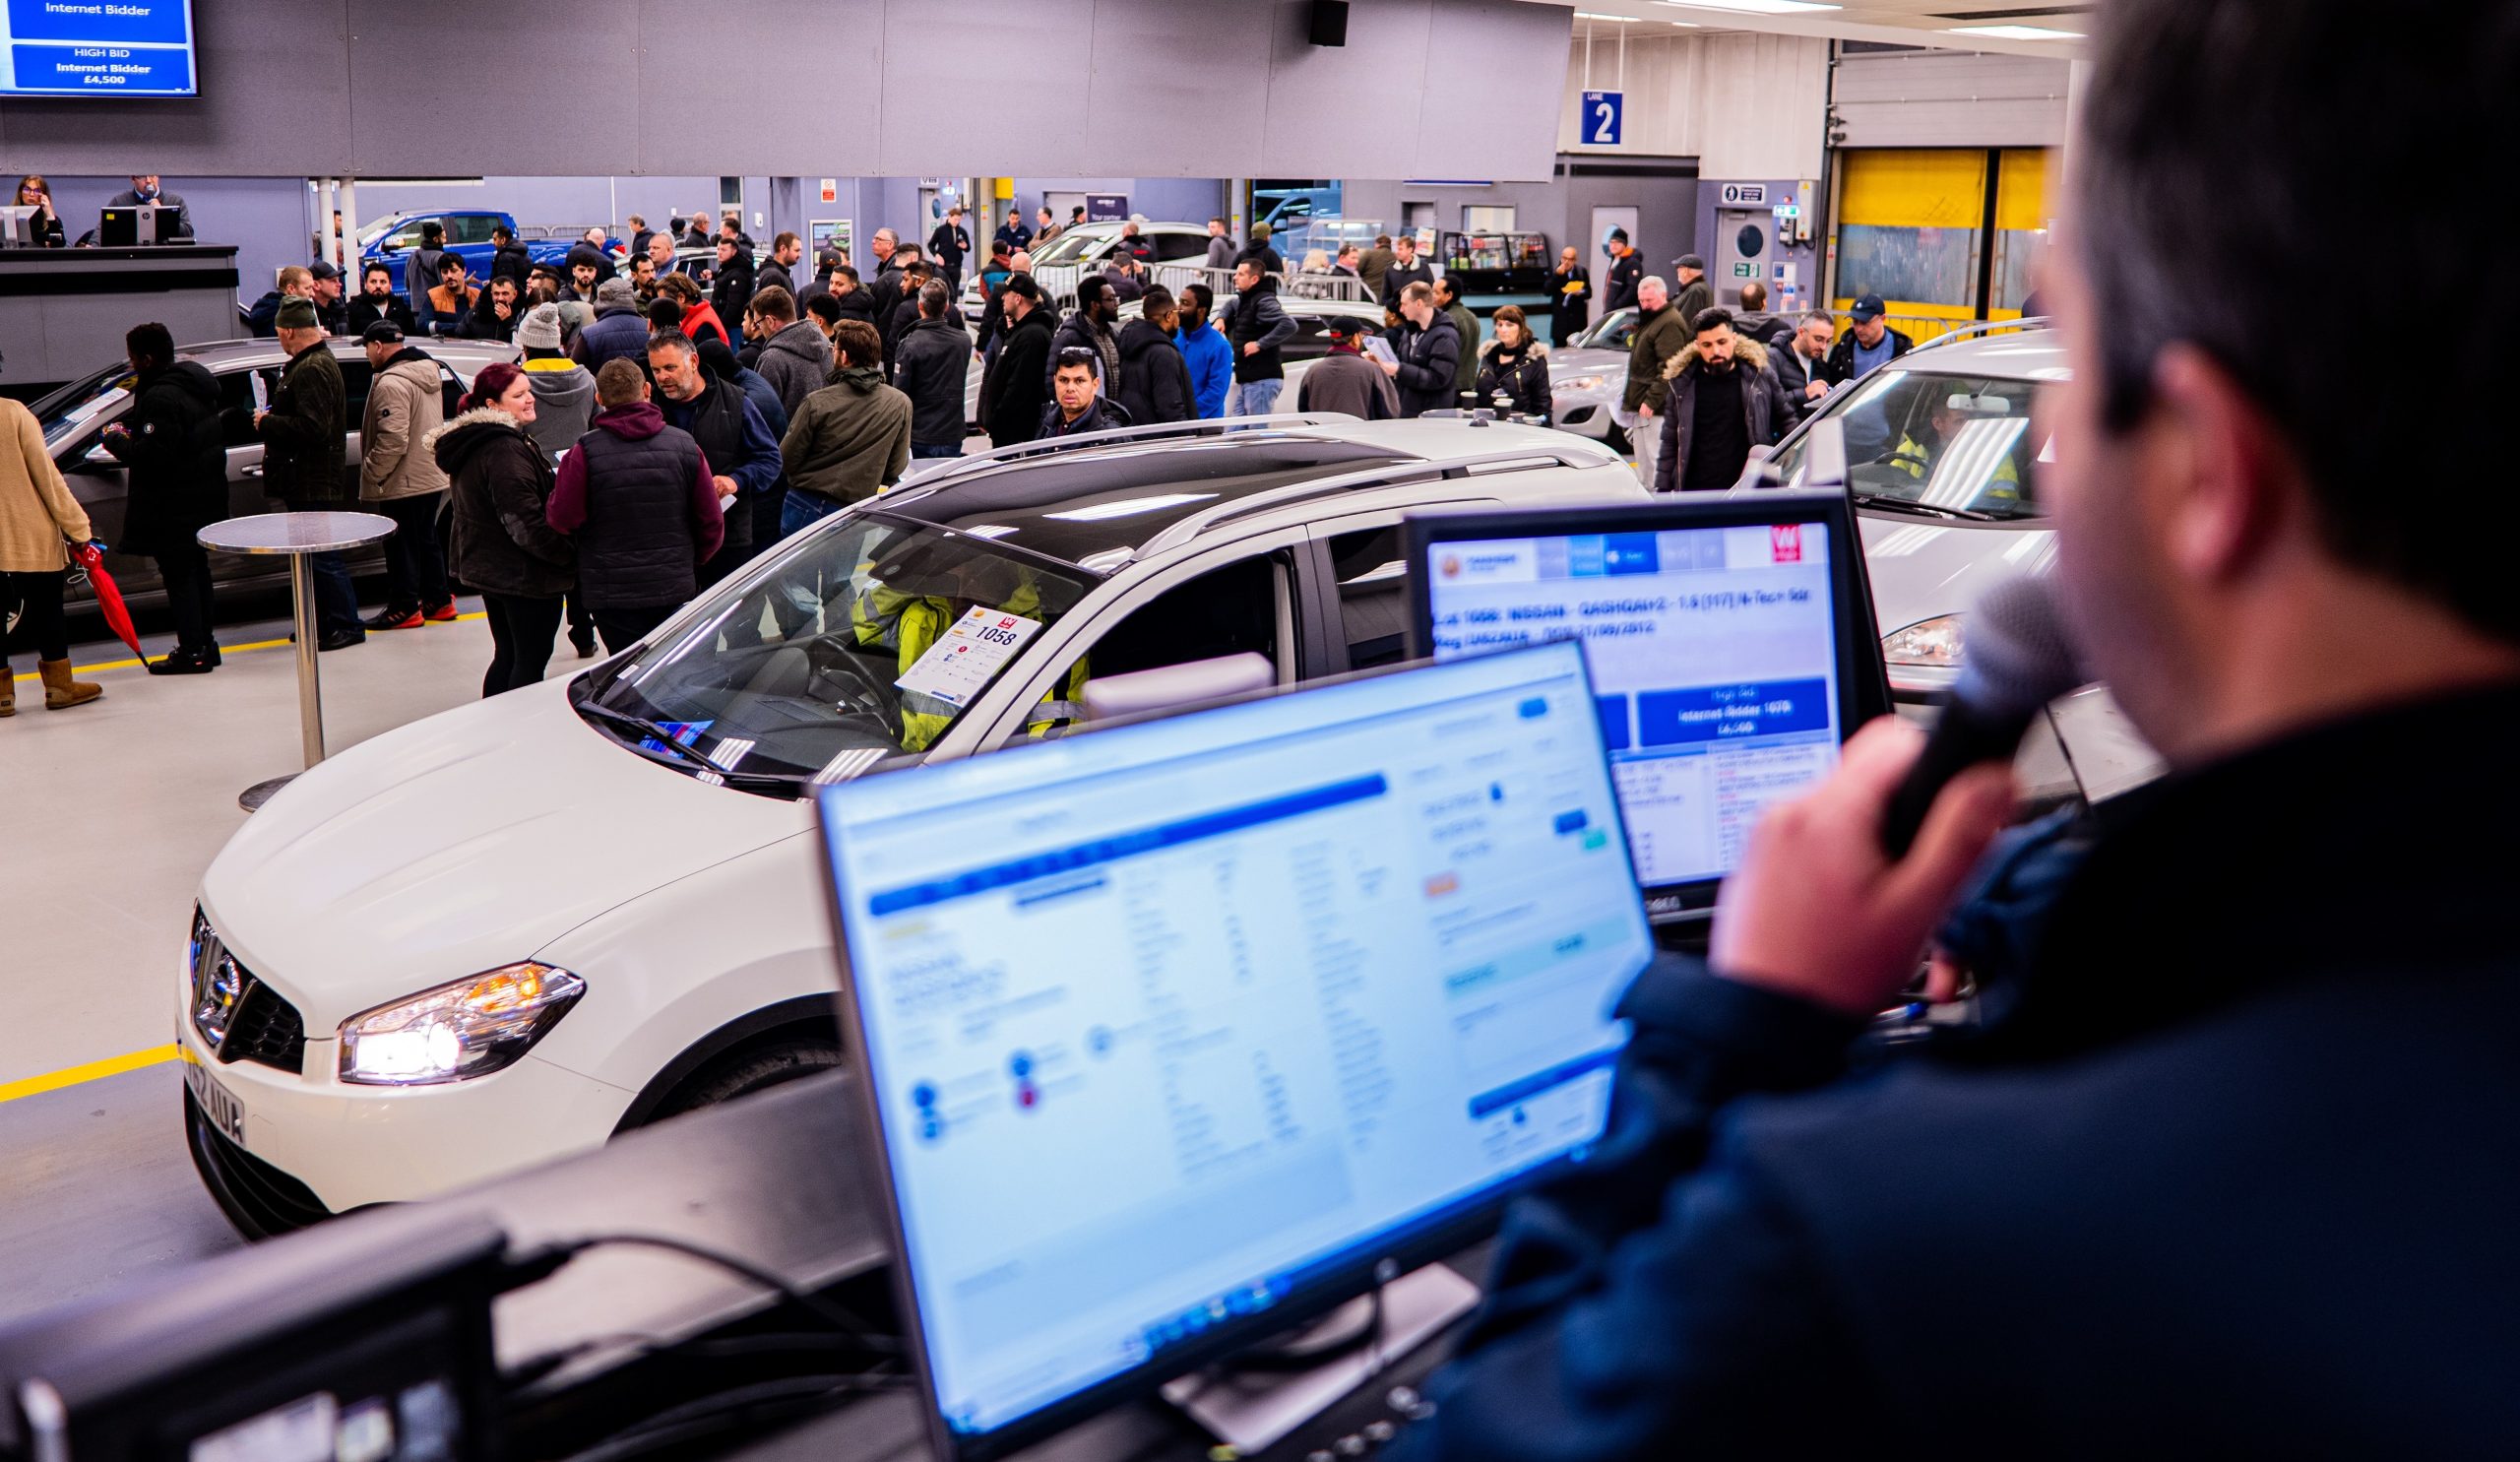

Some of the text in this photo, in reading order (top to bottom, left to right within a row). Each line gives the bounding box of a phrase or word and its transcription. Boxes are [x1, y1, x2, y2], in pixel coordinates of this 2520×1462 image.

[46, 3, 151, 16] Internet Bidder
[75, 48, 130, 58] HIGH BID
[56, 63, 151, 74] Internet Bidder
[84, 75, 126, 85] £4,500
[1587, 92, 1604, 101] LANE
[1594, 102, 1614, 143] 2
[976, 625, 1018, 646] 1058
[211, 1082, 244, 1144] AUA
